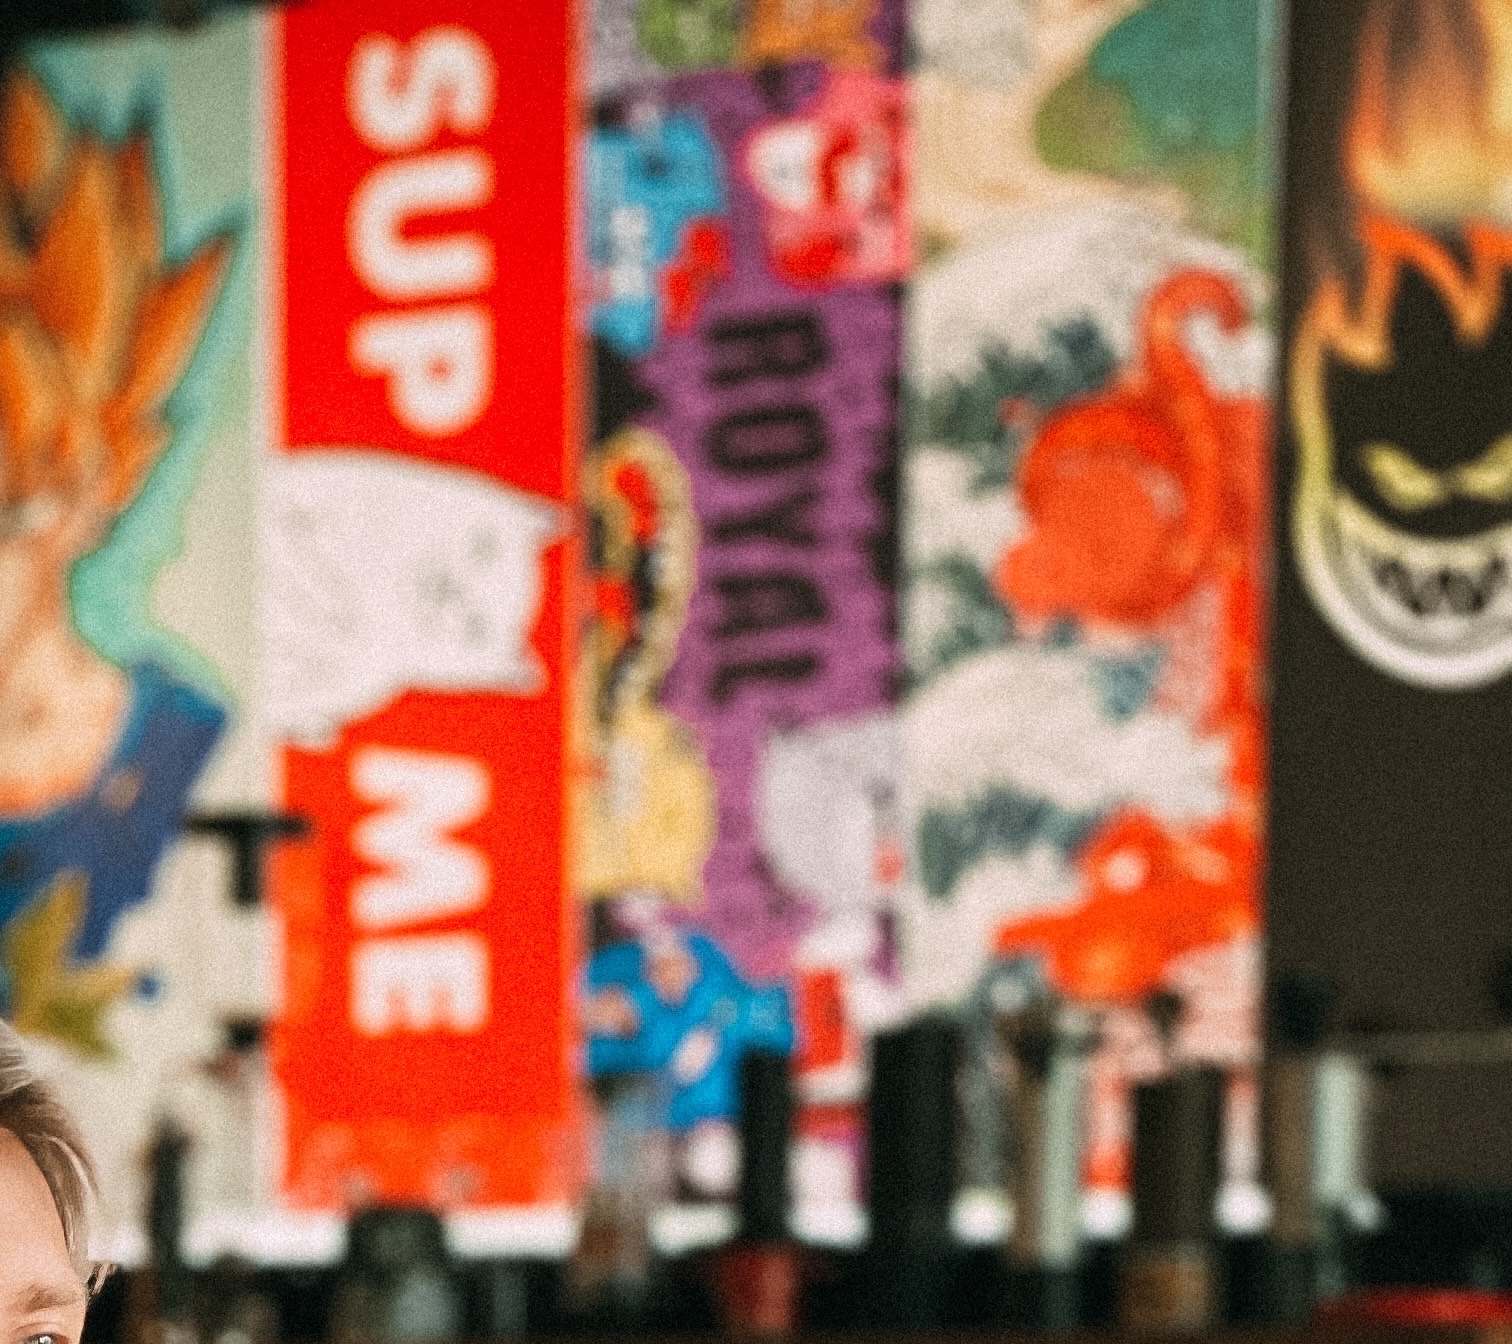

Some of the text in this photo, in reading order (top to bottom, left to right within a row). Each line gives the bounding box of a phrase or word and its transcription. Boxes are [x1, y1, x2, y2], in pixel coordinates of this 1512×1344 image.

[348, 30, 492, 1037] SUP ME
[706, 310, 830, 700] ROYAL
